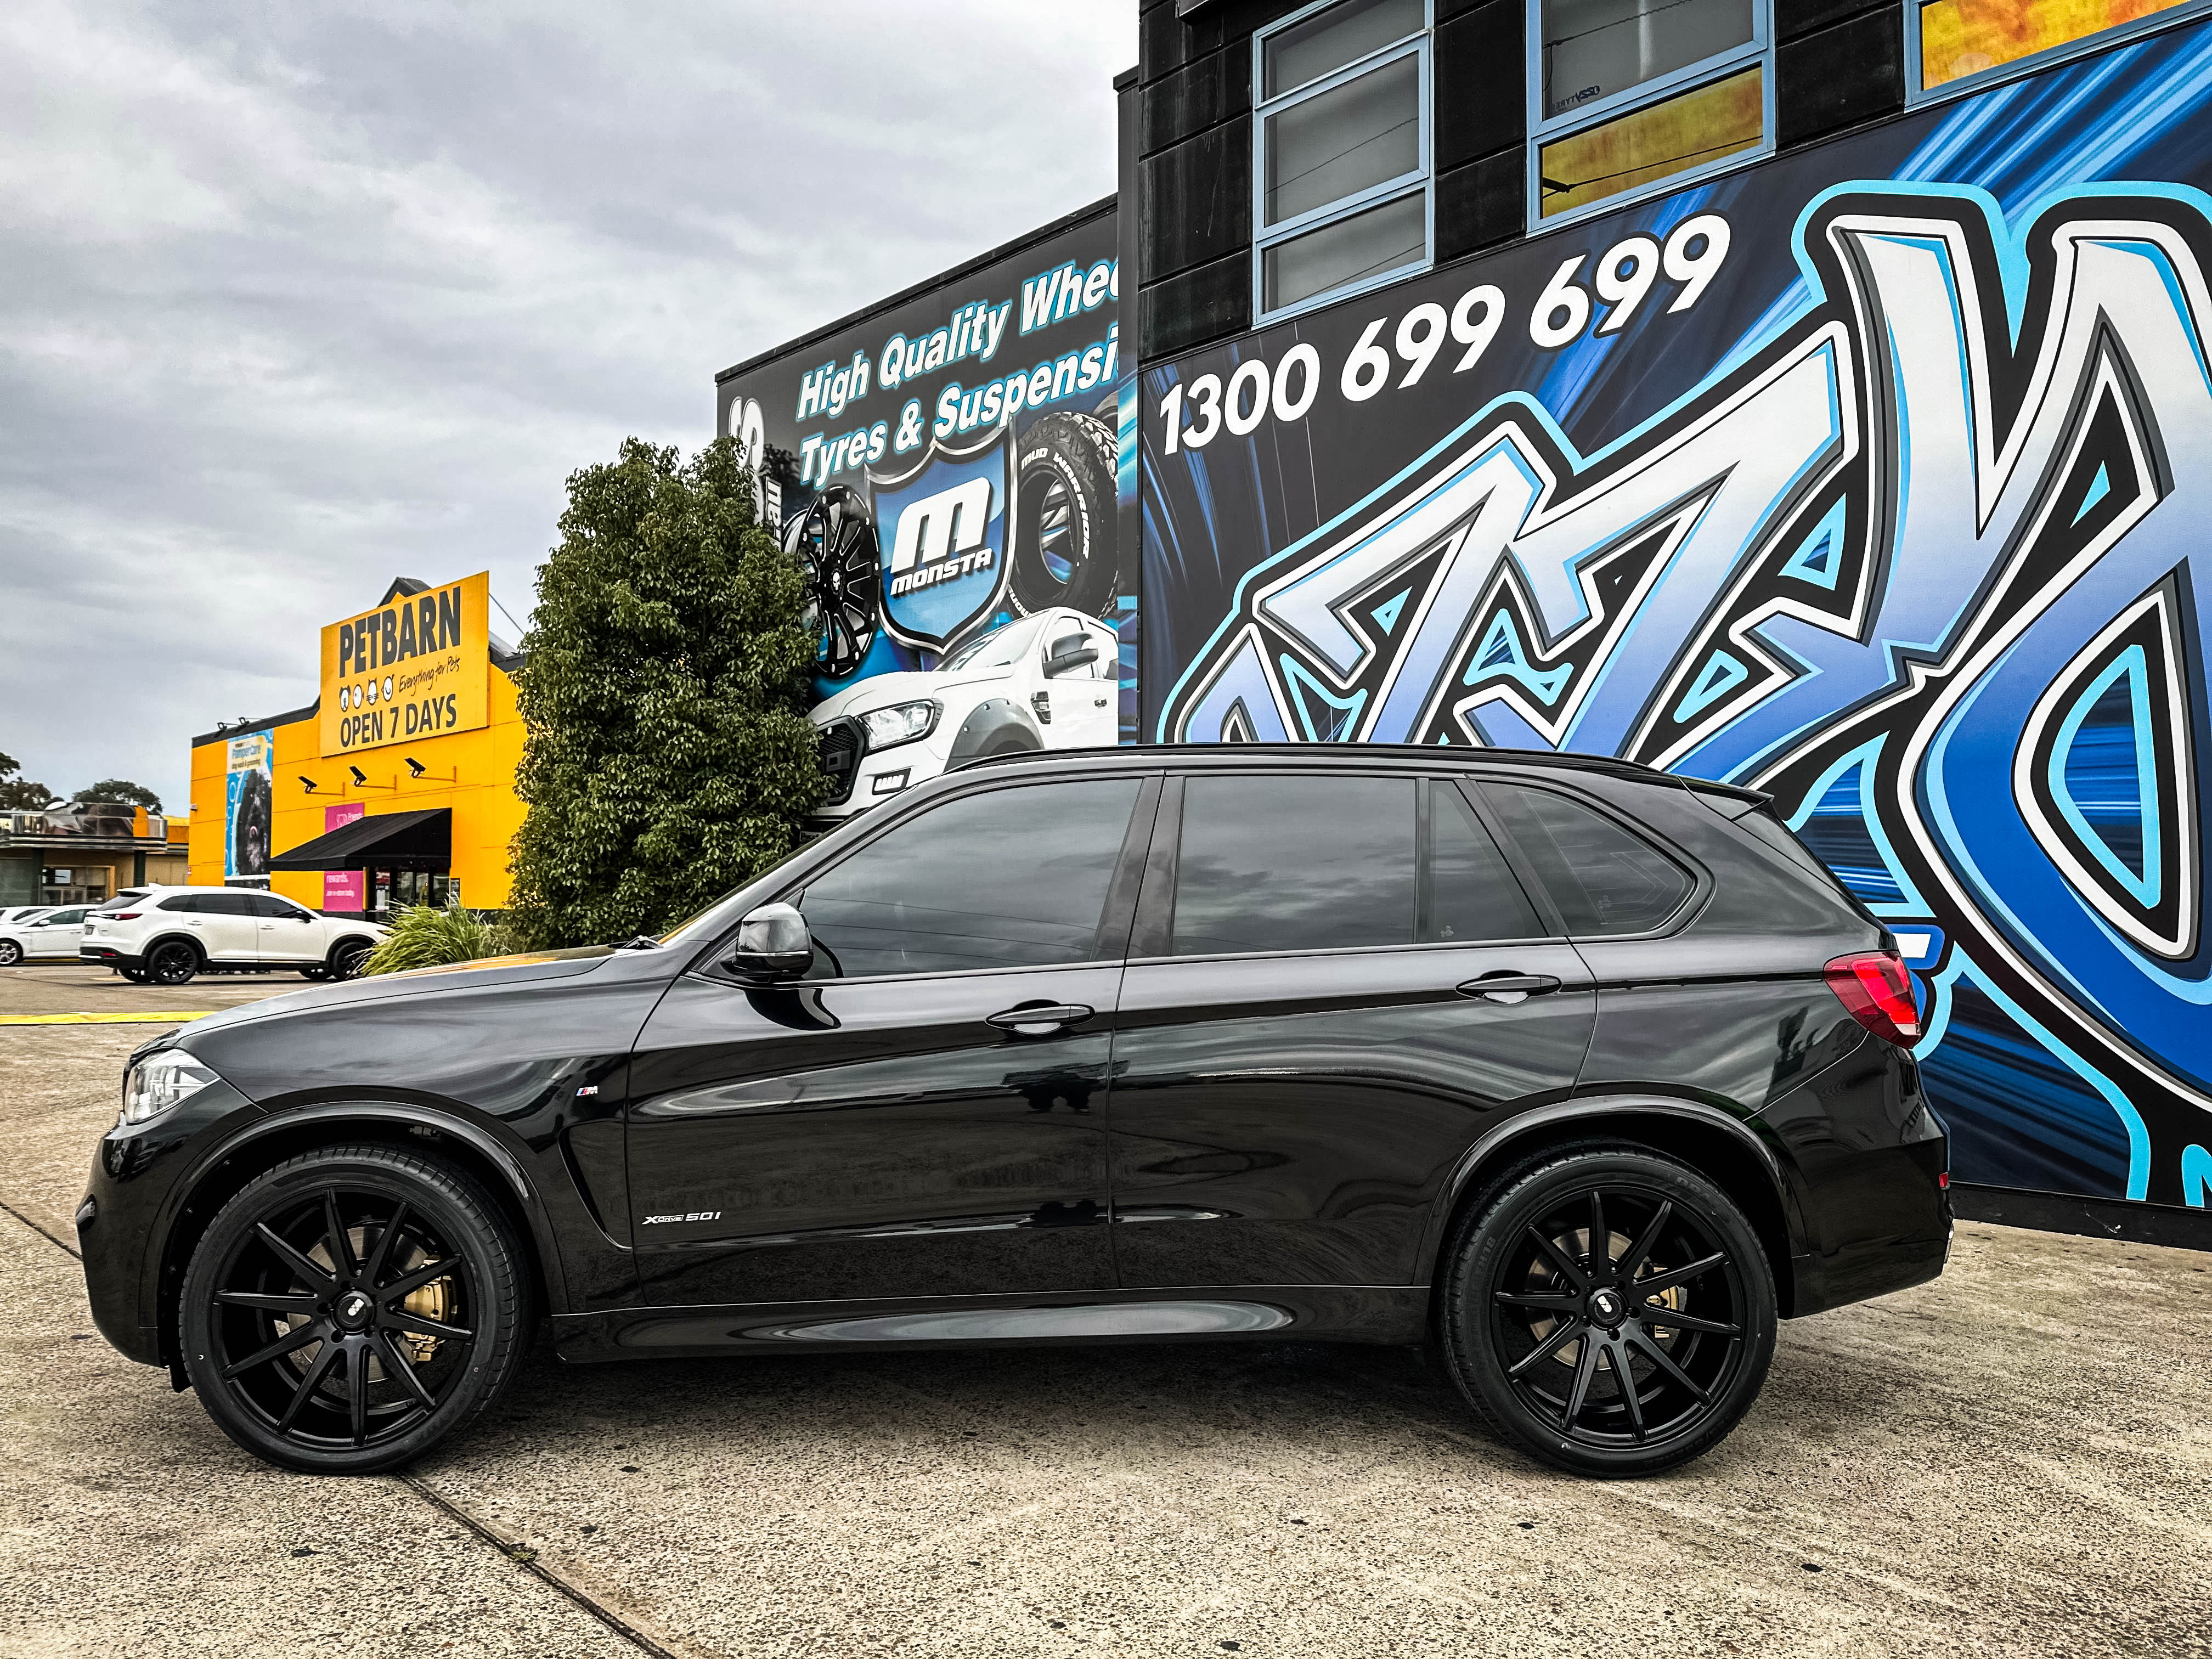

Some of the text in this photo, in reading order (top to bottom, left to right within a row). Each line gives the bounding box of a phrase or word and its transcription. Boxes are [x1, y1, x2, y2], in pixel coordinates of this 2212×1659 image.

[797, 353, 870, 420] High
[879, 303, 1011, 387] Quality
[1159, 214, 1731, 456] 1300 699 699
[801, 424, 887, 488] Tyres
[895, 402, 923, 452] &
[934, 326, 1118, 437] Suspensi
[1020, 447, 1091, 560] MUD WARRIOR
[890, 548, 992, 596] MONSTA
[339, 585, 461, 679] PETBARN
[398, 654, 460, 697] Everything for Pets
[340, 693, 456, 748] OPEN 7 DAYS
